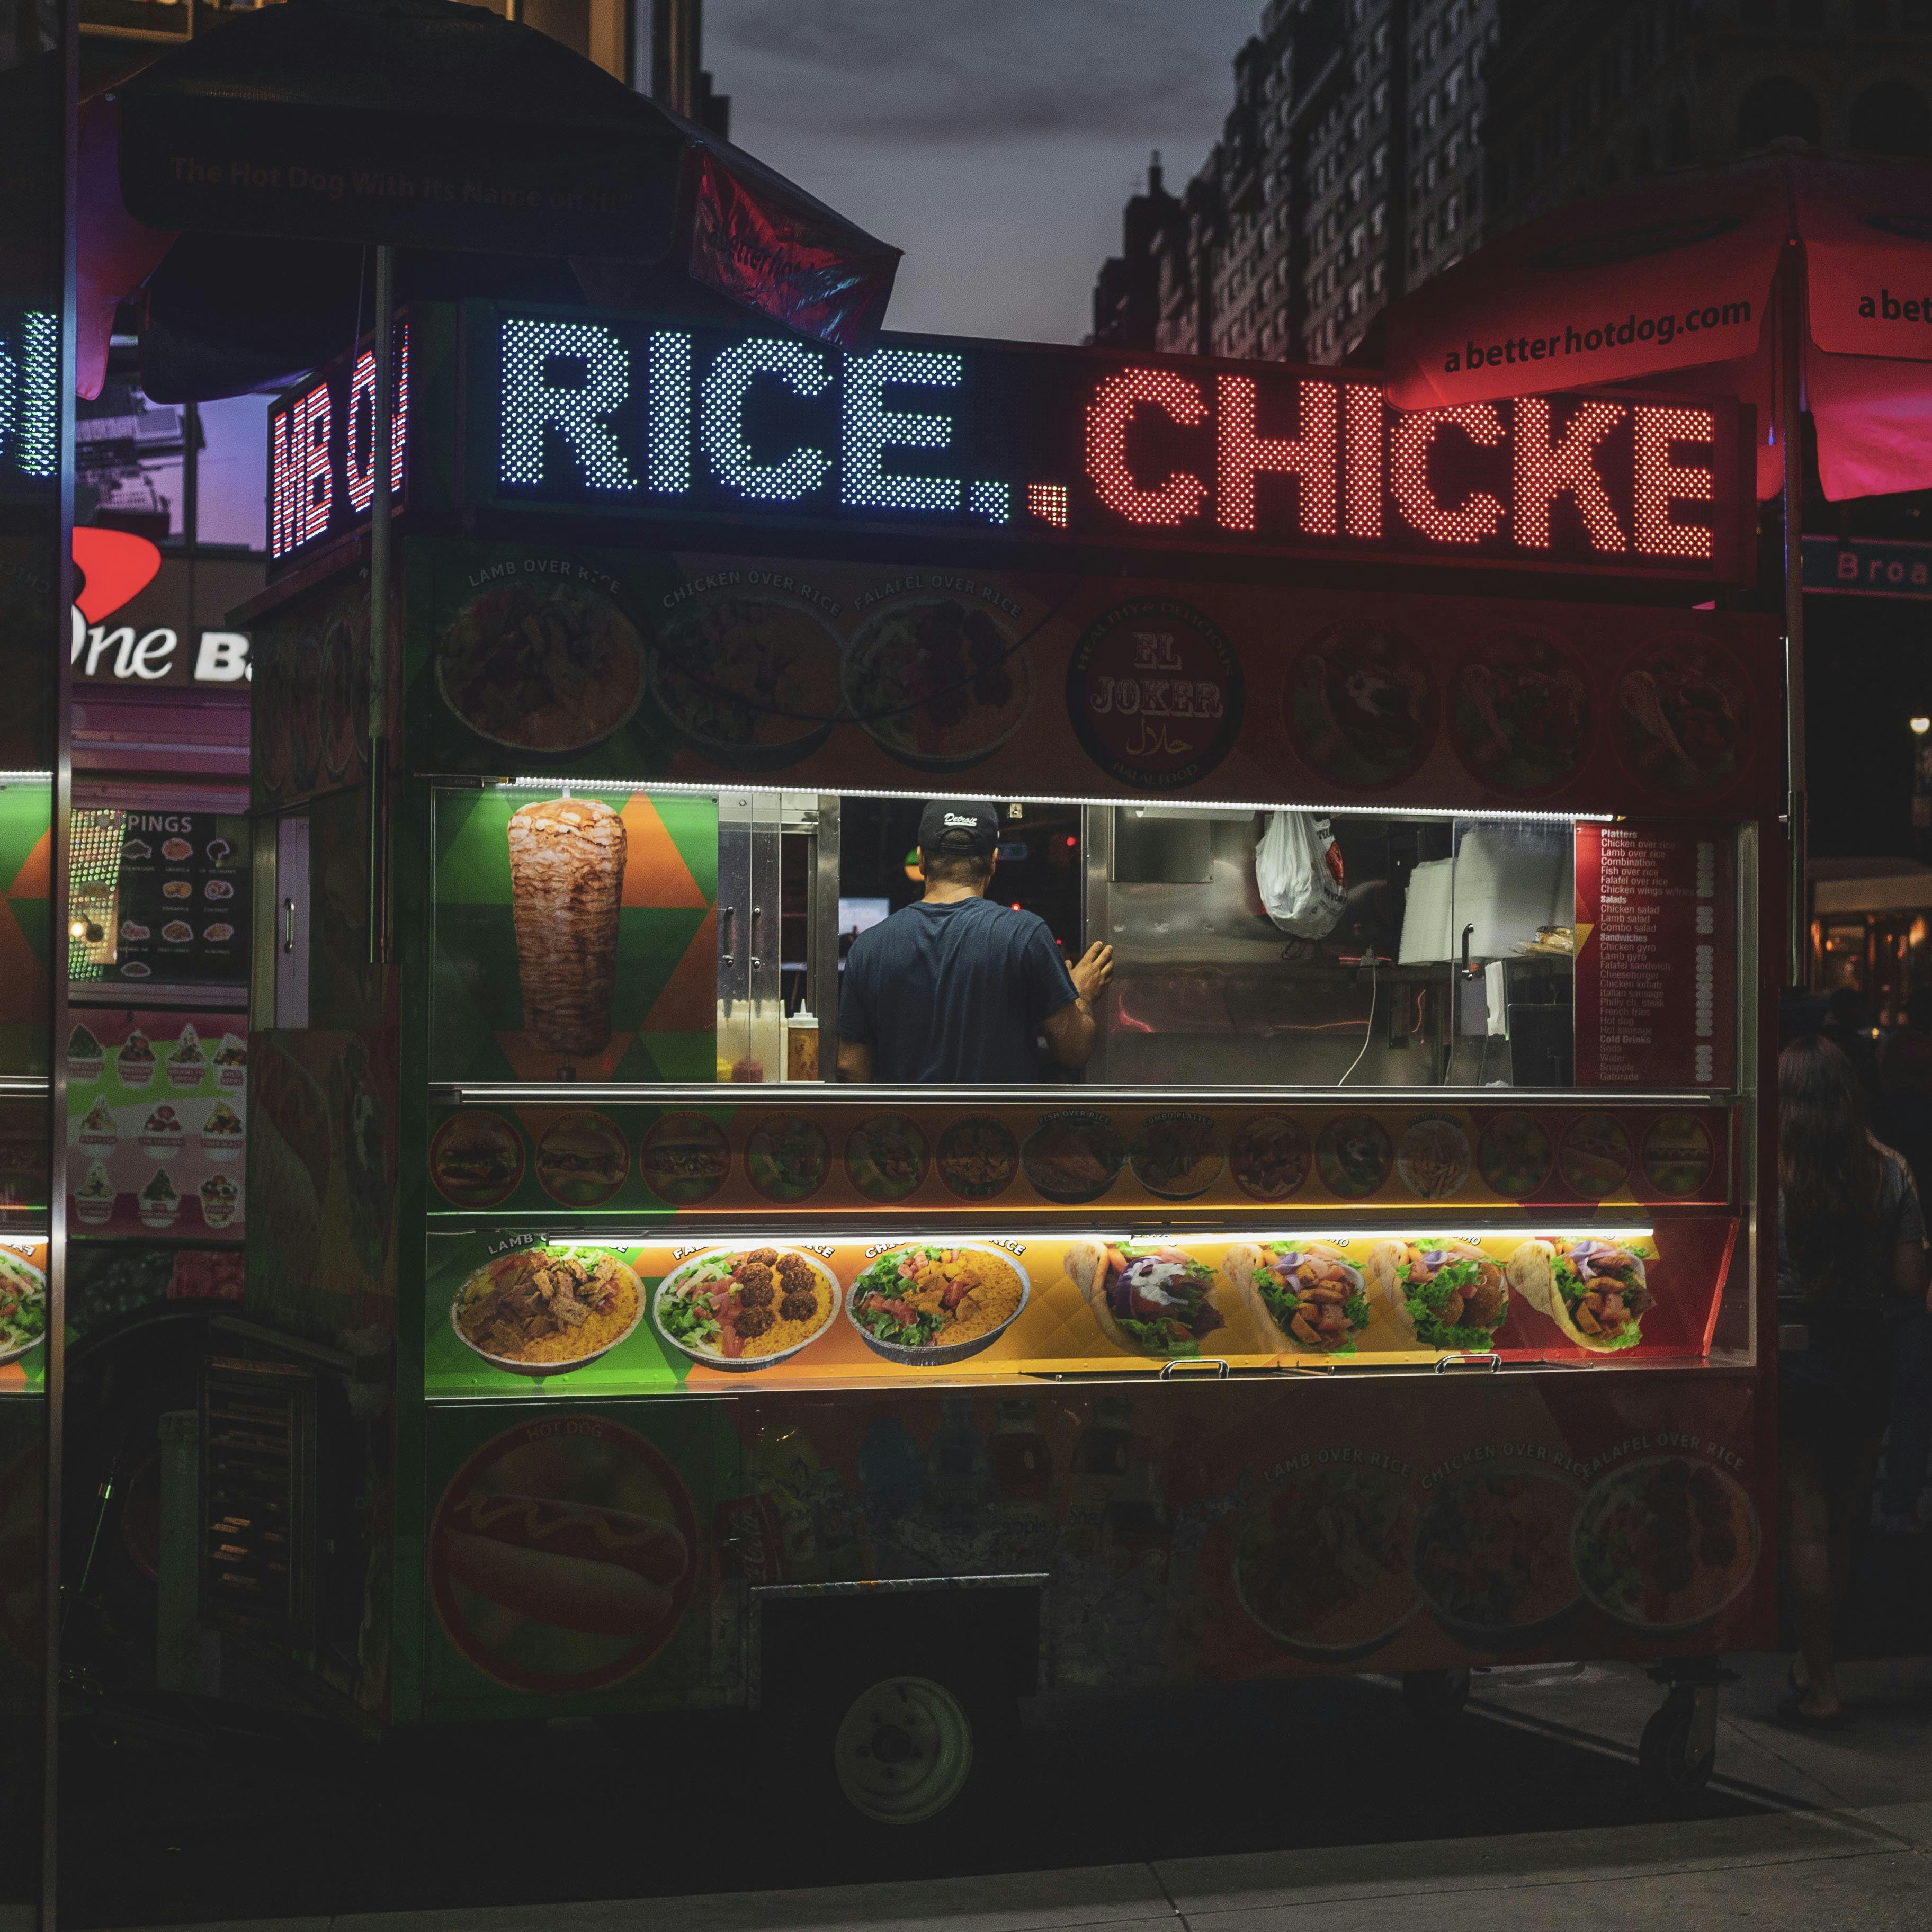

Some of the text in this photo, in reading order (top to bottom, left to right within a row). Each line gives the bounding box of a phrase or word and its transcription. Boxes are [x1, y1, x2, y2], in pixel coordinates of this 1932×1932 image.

[171, 157, 222, 183] The
[230, 160, 281, 187] Hot
[288, 166, 344, 199] Dog
[351, 170, 415, 198] With
[463, 179, 541, 208] Name
[1085, 367, 1714, 559] CHICKE
[468, 560, 517, 588] LAMB
[523, 559, 571, 576] OVER
[1837, 552, 1928, 584] Broa
[662, 569, 842, 618] CHICKEN OVER RICE
[853, 574, 1022, 619] FALAFEL OVER RICE
[1133, 631, 1183, 670] EL
[1090, 676, 1224, 718] JOKER
[944, 812, 978, 824] Detroit
[1600, 829, 1638, 839] Platters
[1600, 838, 1635, 848] Chicken
[1600, 848, 1625, 857] Lamb
[1600, 857, 1656, 866] Combination
[1600, 866, 1618, 875] Fish
[1600, 875, 1629, 885] Falafel
[1652, 878, 1668, 887] rice
[1600, 884, 1635, 894] Chicken
[1637, 887, 1663, 896] wings
[1600, 895, 1627, 904] Salads
[1600, 904, 1660, 914] Chicken salad
[1600, 914, 1650, 923] Lamb salad
[1600, 923, 1657, 933] Combo salad
[1600, 933, 1648, 942] Sandwiches
[1600, 942, 1657, 953] Chicken gyro
[1600, 951, 1647, 962] Lamb gyro
[1600, 961, 1670, 971] Falafel sandwich
[1600, 970, 1660, 980] Cheeseburger
[1600, 979, 1634, 989] Chicken
[1600, 1007, 1629, 1016] French
[1599, 1034, 1652, 1044] Cold Drinks
[1039, 1109, 1111, 1125] FISH OVER RICE
[1142, 1112, 1214, 1127] COMBO PLATTER
[487, 1233, 534, 1255] LAMB
[526, 1420, 603, 1442] HOT DOG
[1581, 1432, 1746, 1479] FALAFEL OVER RICE
[1263, 1447, 1412, 1483] LAMB OVER RICE
[1420, 1444, 1496, 1490] CHICKEN
[1502, 1442, 1548, 1461] OVER
